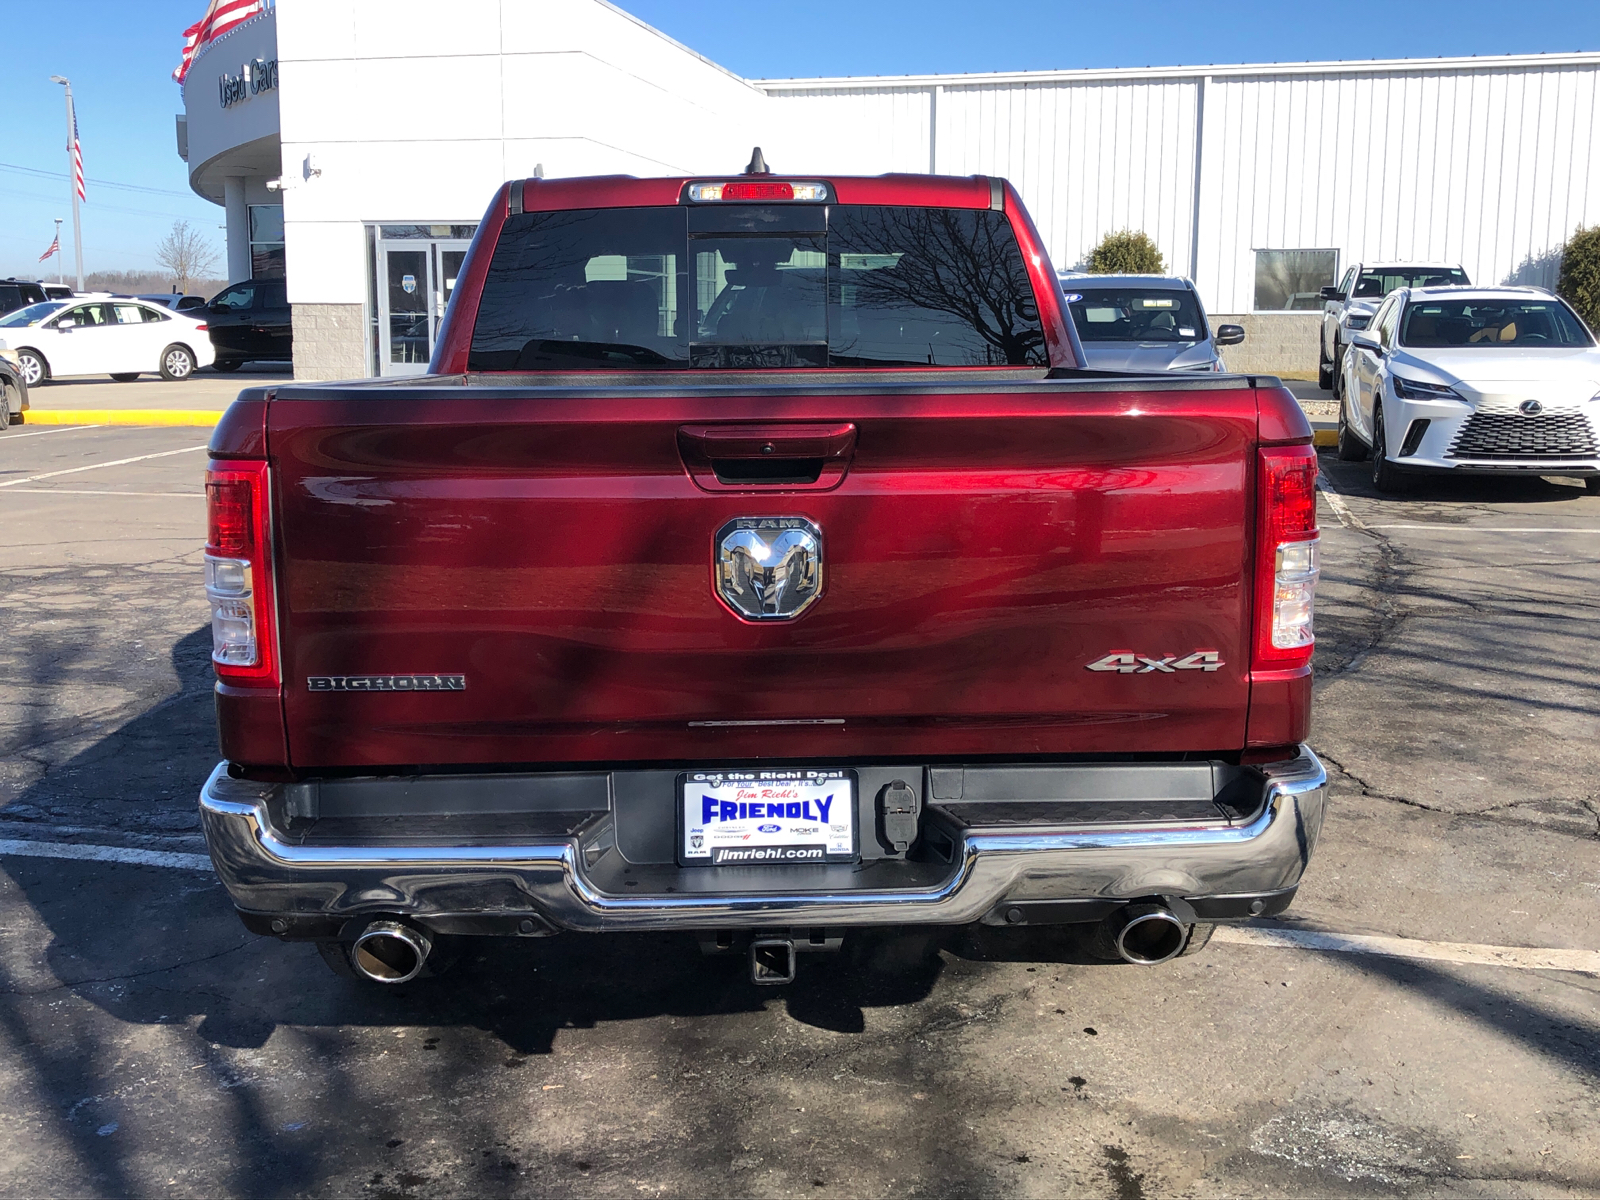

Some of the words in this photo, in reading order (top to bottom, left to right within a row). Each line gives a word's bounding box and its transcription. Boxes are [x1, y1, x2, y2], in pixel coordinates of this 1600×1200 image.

[219, 64, 247, 108] Used
[250, 58, 279, 95] Cars
[736, 519, 801, 529] RAM
[307, 674, 467, 692] BIGHORN
[693, 773, 724, 781] Get
[727, 772, 755, 780] the
[759, 771, 802, 779] Riehl
[806, 770, 843, 778] Deal
[735, 789, 758, 801] Jim
[761, 789, 799, 799] Riehl's
[702, 794, 834, 825] FRIENDLY
[761, 824, 779, 833] Ford
[716, 848, 823, 862] jimriehl.com
